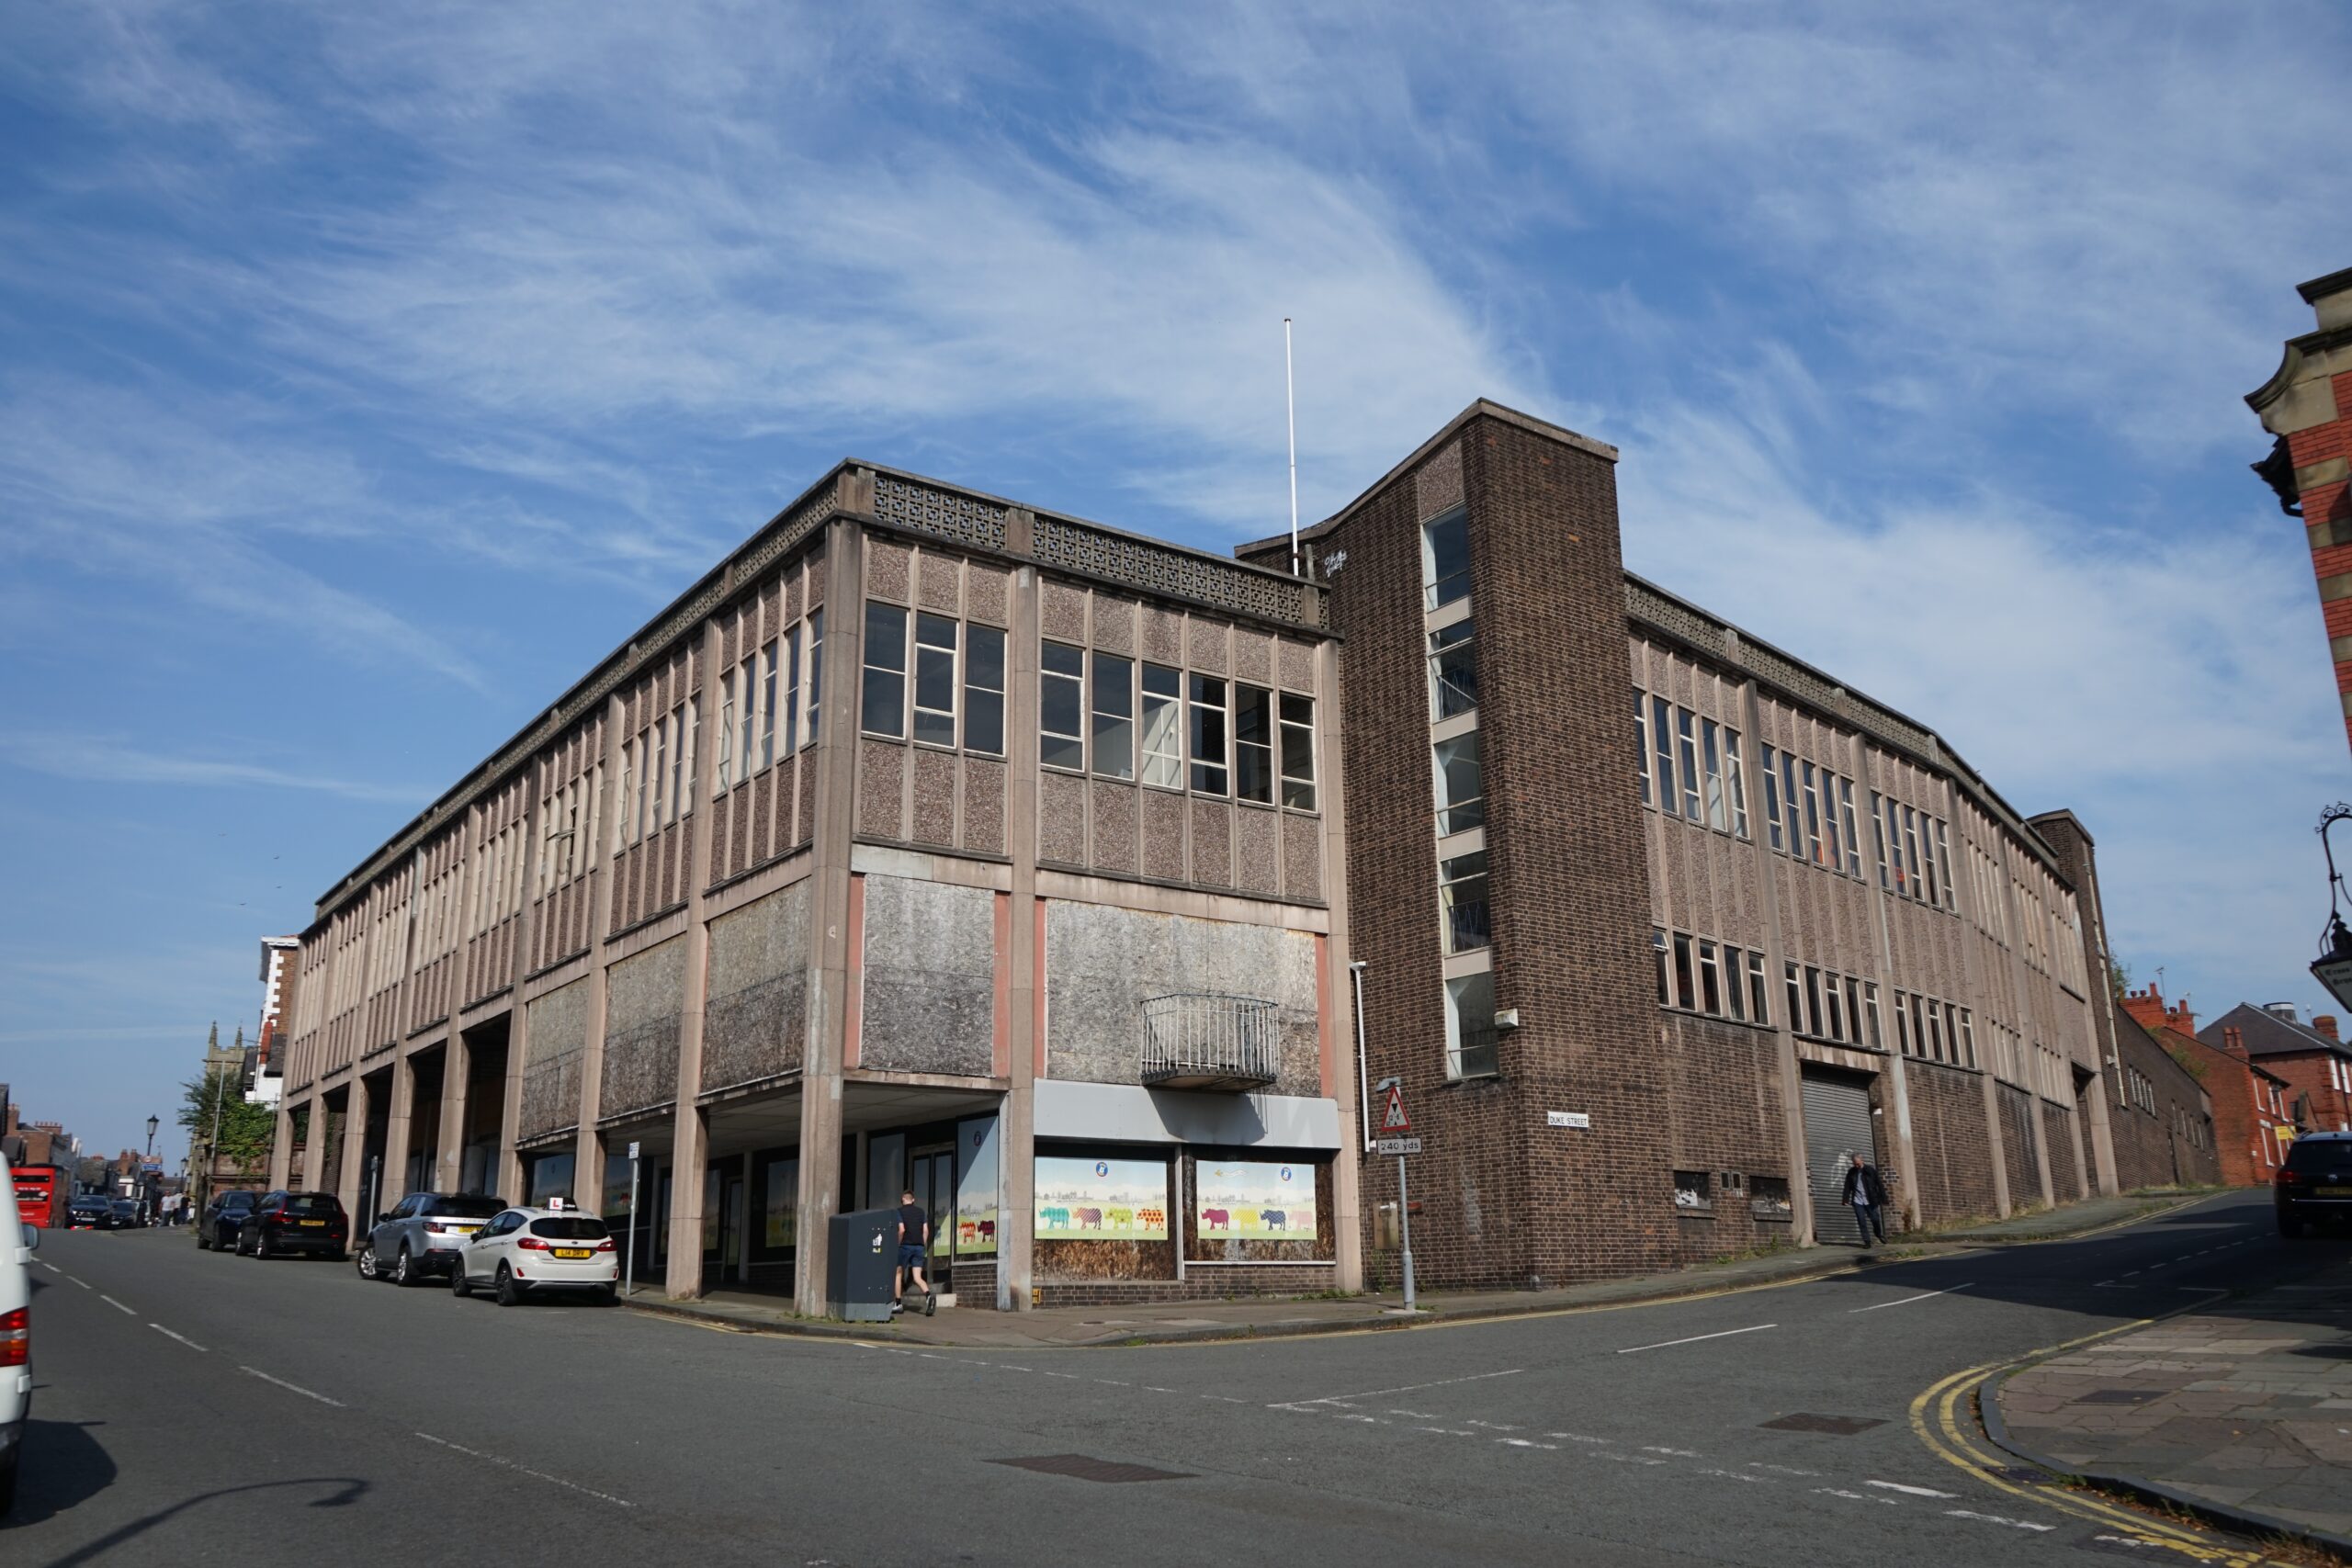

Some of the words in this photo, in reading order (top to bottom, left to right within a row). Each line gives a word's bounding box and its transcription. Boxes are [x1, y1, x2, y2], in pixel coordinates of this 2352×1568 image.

[1550, 1116, 1565, 1124] DUKE
[1566, 1117, 1587, 1126] STREET
[1381, 1143, 1399, 1151] 240
[1403, 1142, 1419, 1151] yds
[553, 1200, 560, 1208] L
